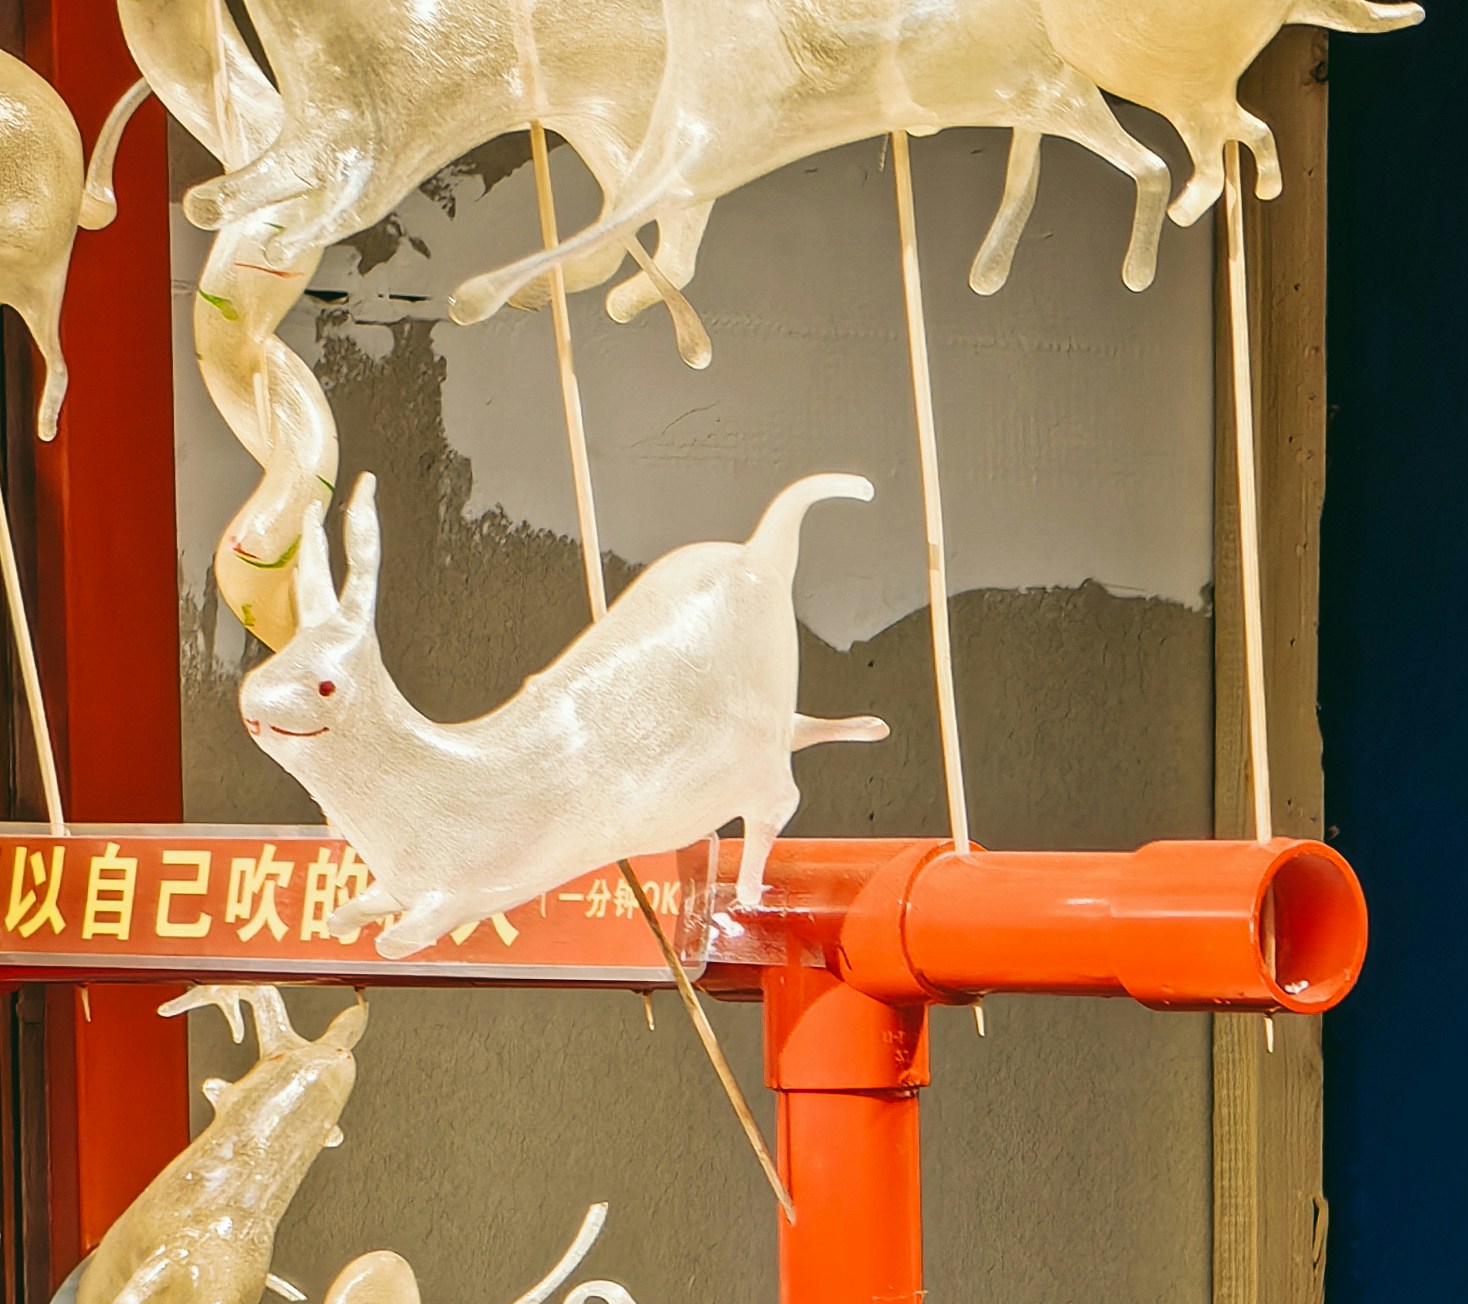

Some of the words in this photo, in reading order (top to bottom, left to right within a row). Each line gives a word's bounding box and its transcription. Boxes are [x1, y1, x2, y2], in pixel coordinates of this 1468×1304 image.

[4, 842, 519, 947] 以自己吹的
